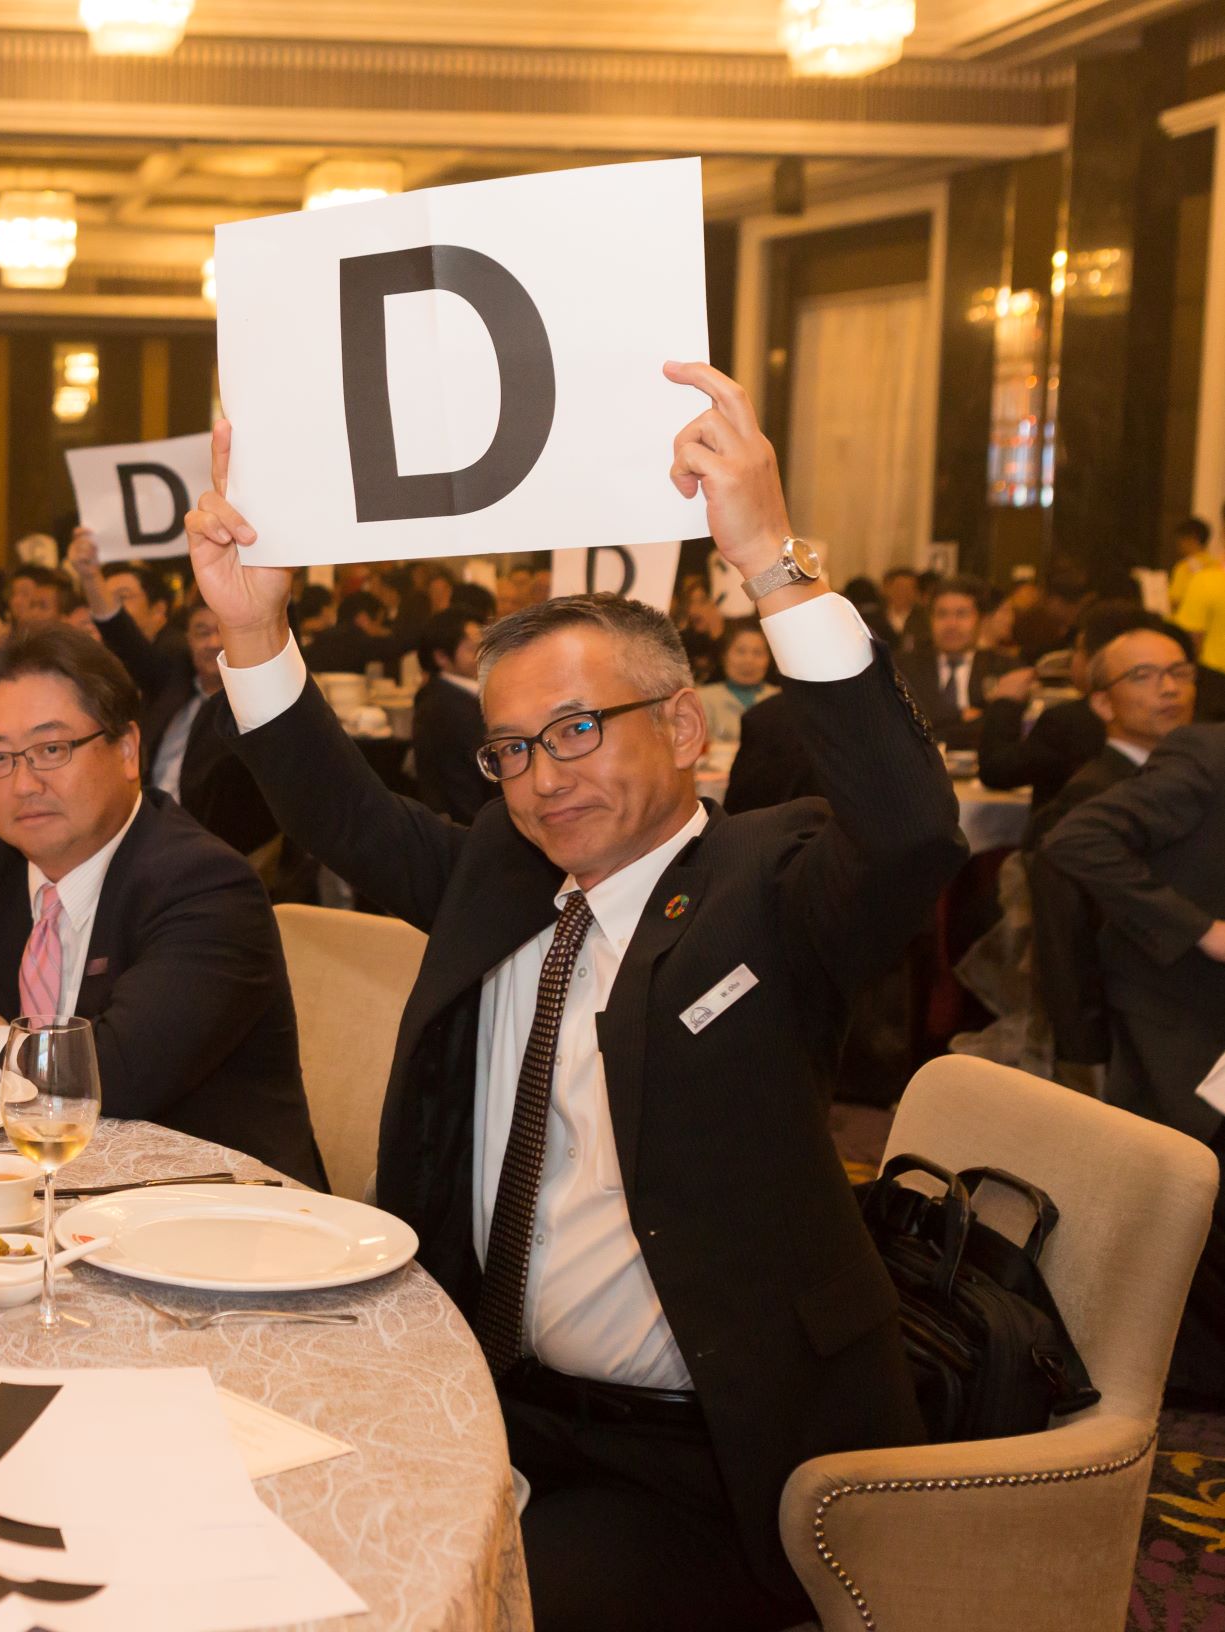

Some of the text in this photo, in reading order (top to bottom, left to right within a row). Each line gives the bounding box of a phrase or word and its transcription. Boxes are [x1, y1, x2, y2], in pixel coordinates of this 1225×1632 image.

[340, 244, 556, 523] D
[116, 462, 190, 546] D
[585, 545, 636, 600] D
